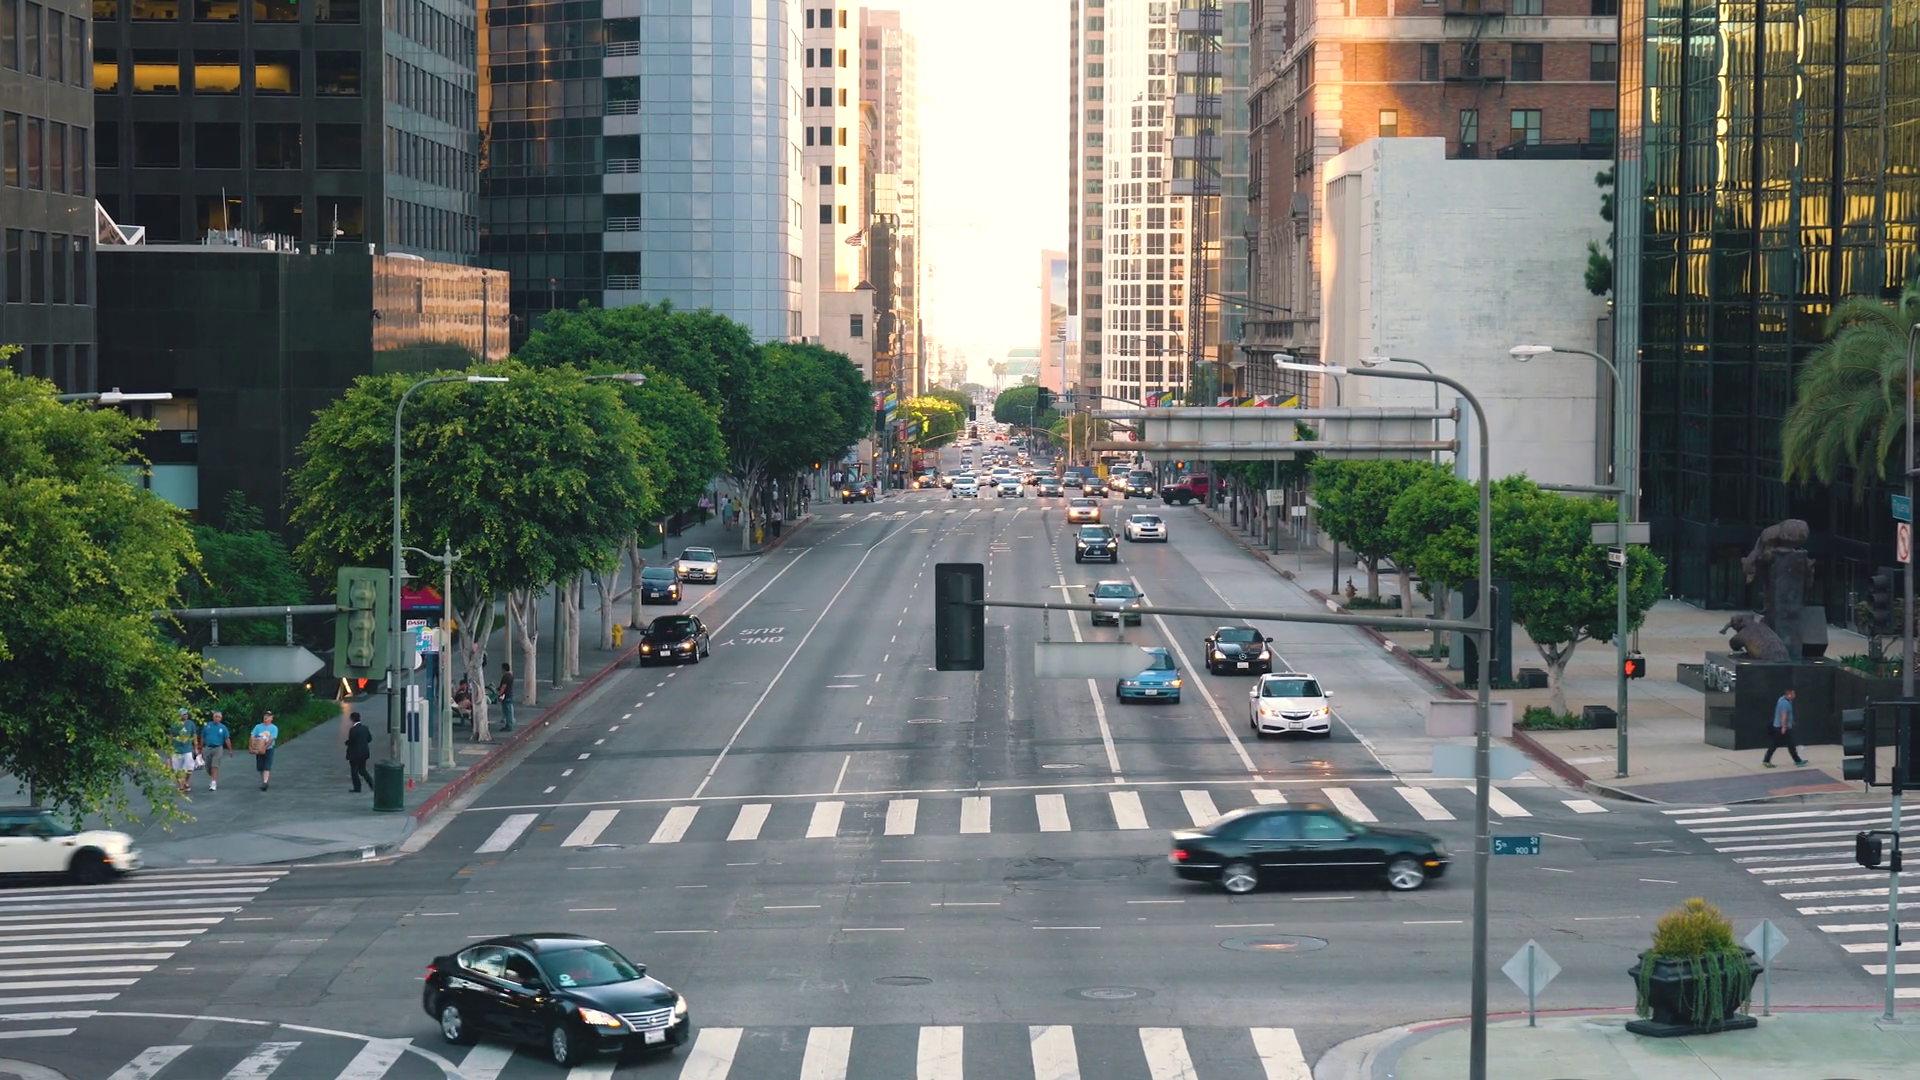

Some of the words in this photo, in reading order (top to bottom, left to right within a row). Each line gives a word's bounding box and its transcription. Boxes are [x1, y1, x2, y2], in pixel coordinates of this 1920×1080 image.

[739, 626, 785, 635] BUS
[719, 636, 784, 646] ONLY
[1515, 847, 1529, 855] 900
